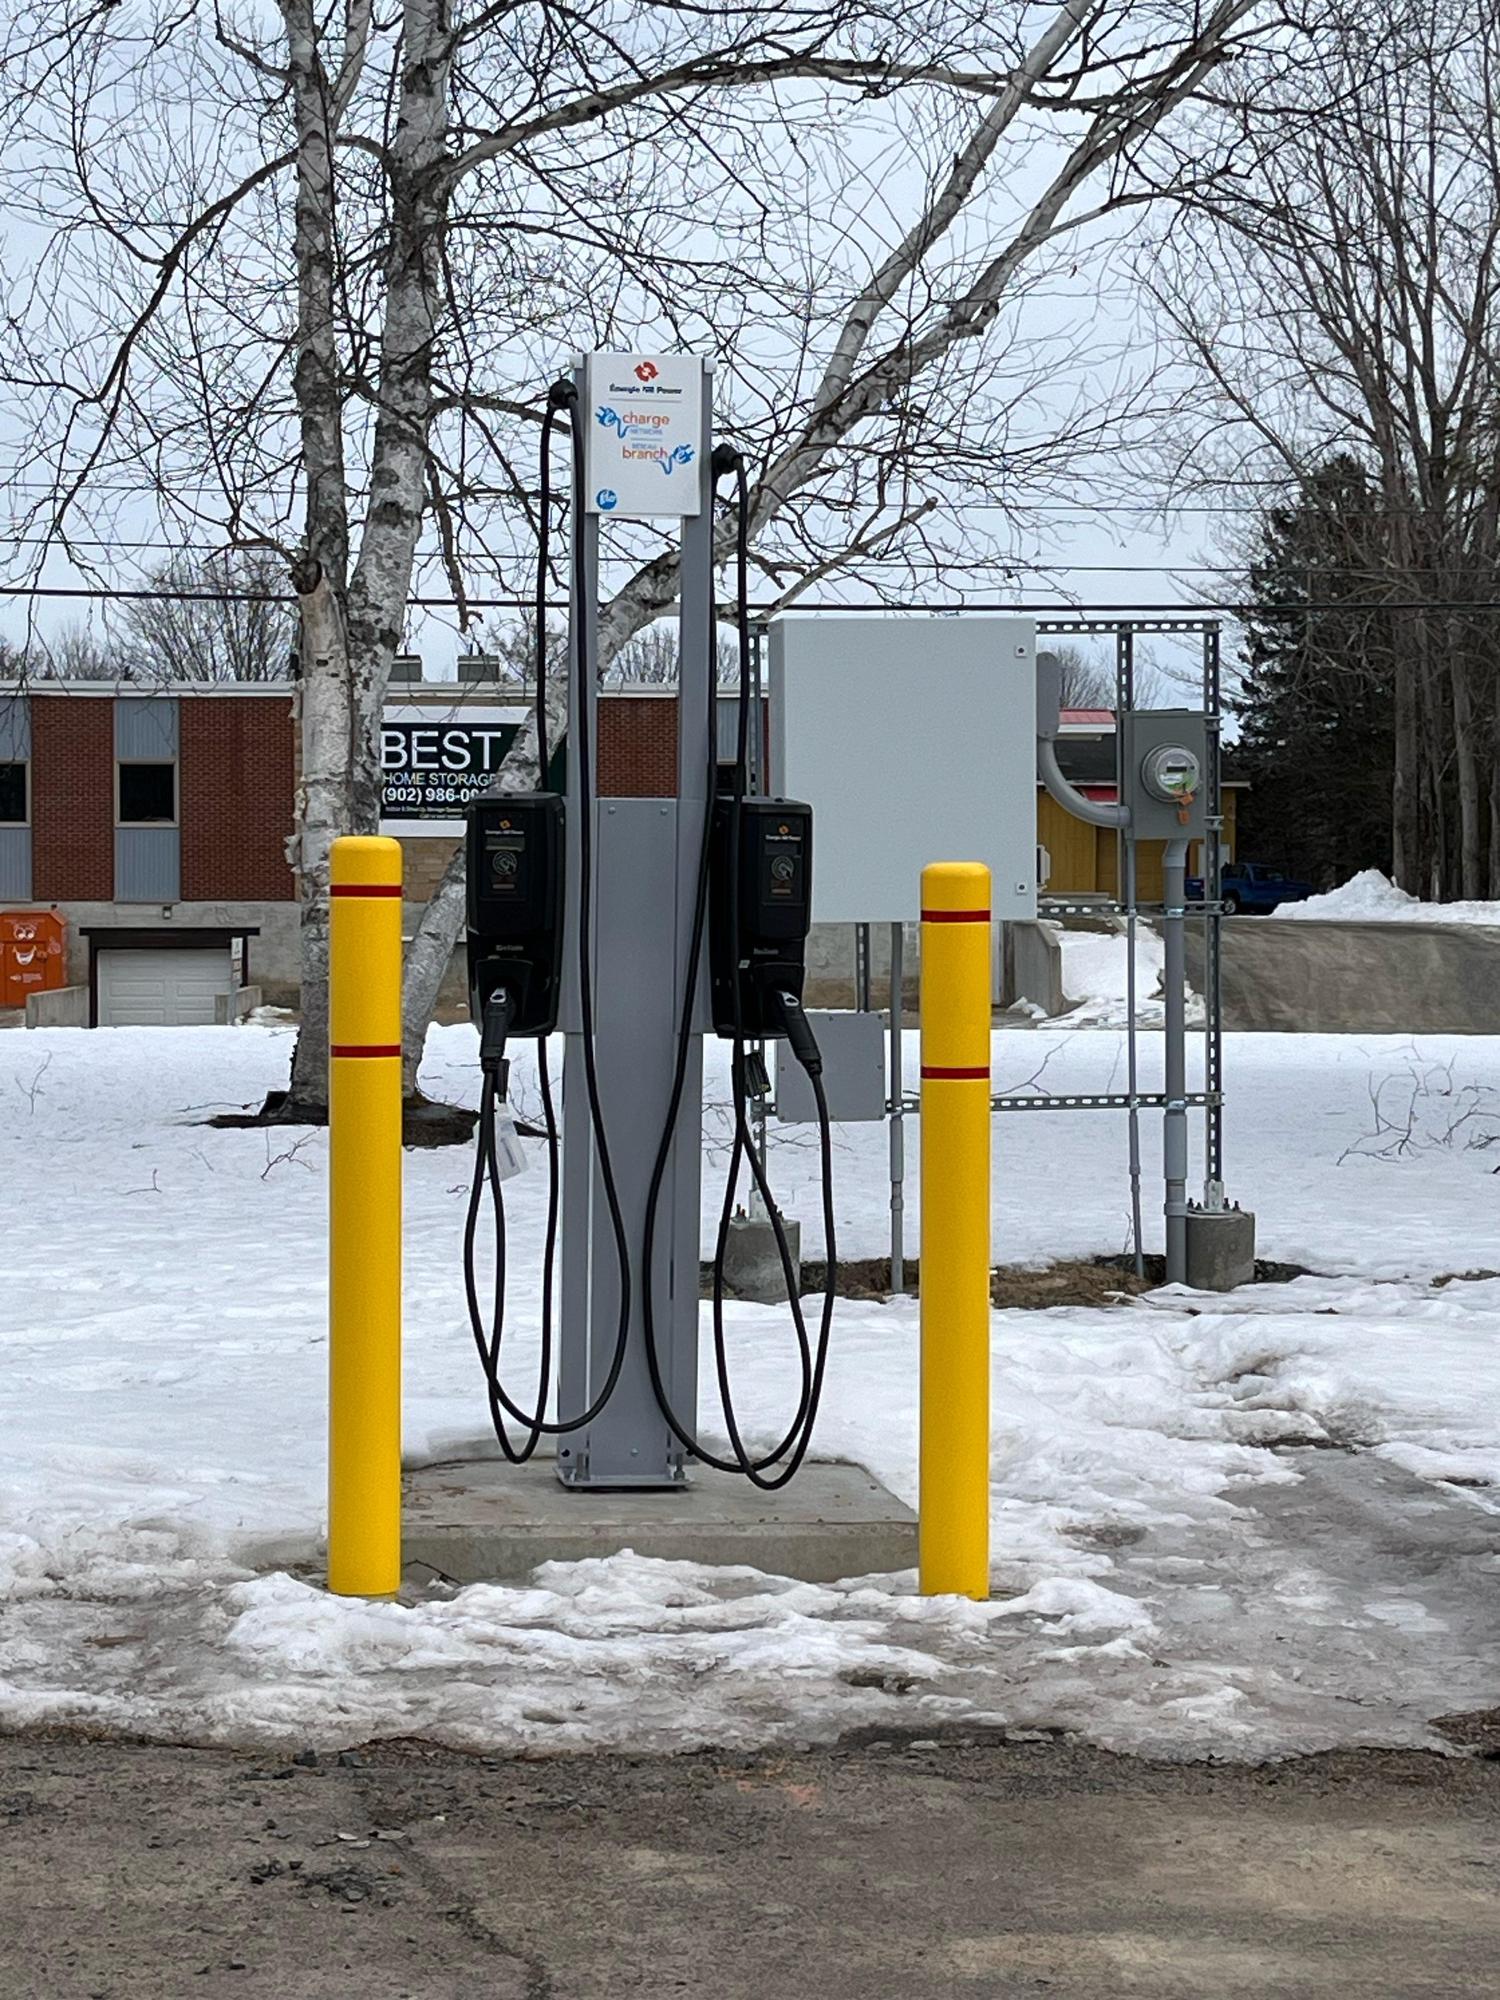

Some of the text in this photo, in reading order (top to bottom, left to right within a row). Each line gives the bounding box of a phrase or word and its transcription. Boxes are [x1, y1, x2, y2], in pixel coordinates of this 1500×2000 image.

[622, 410, 670, 428] charge
[380, 730, 502, 770] BEST
[382, 772, 426, 786] HOME
[381, 787, 487, 805] (902) 986-0
